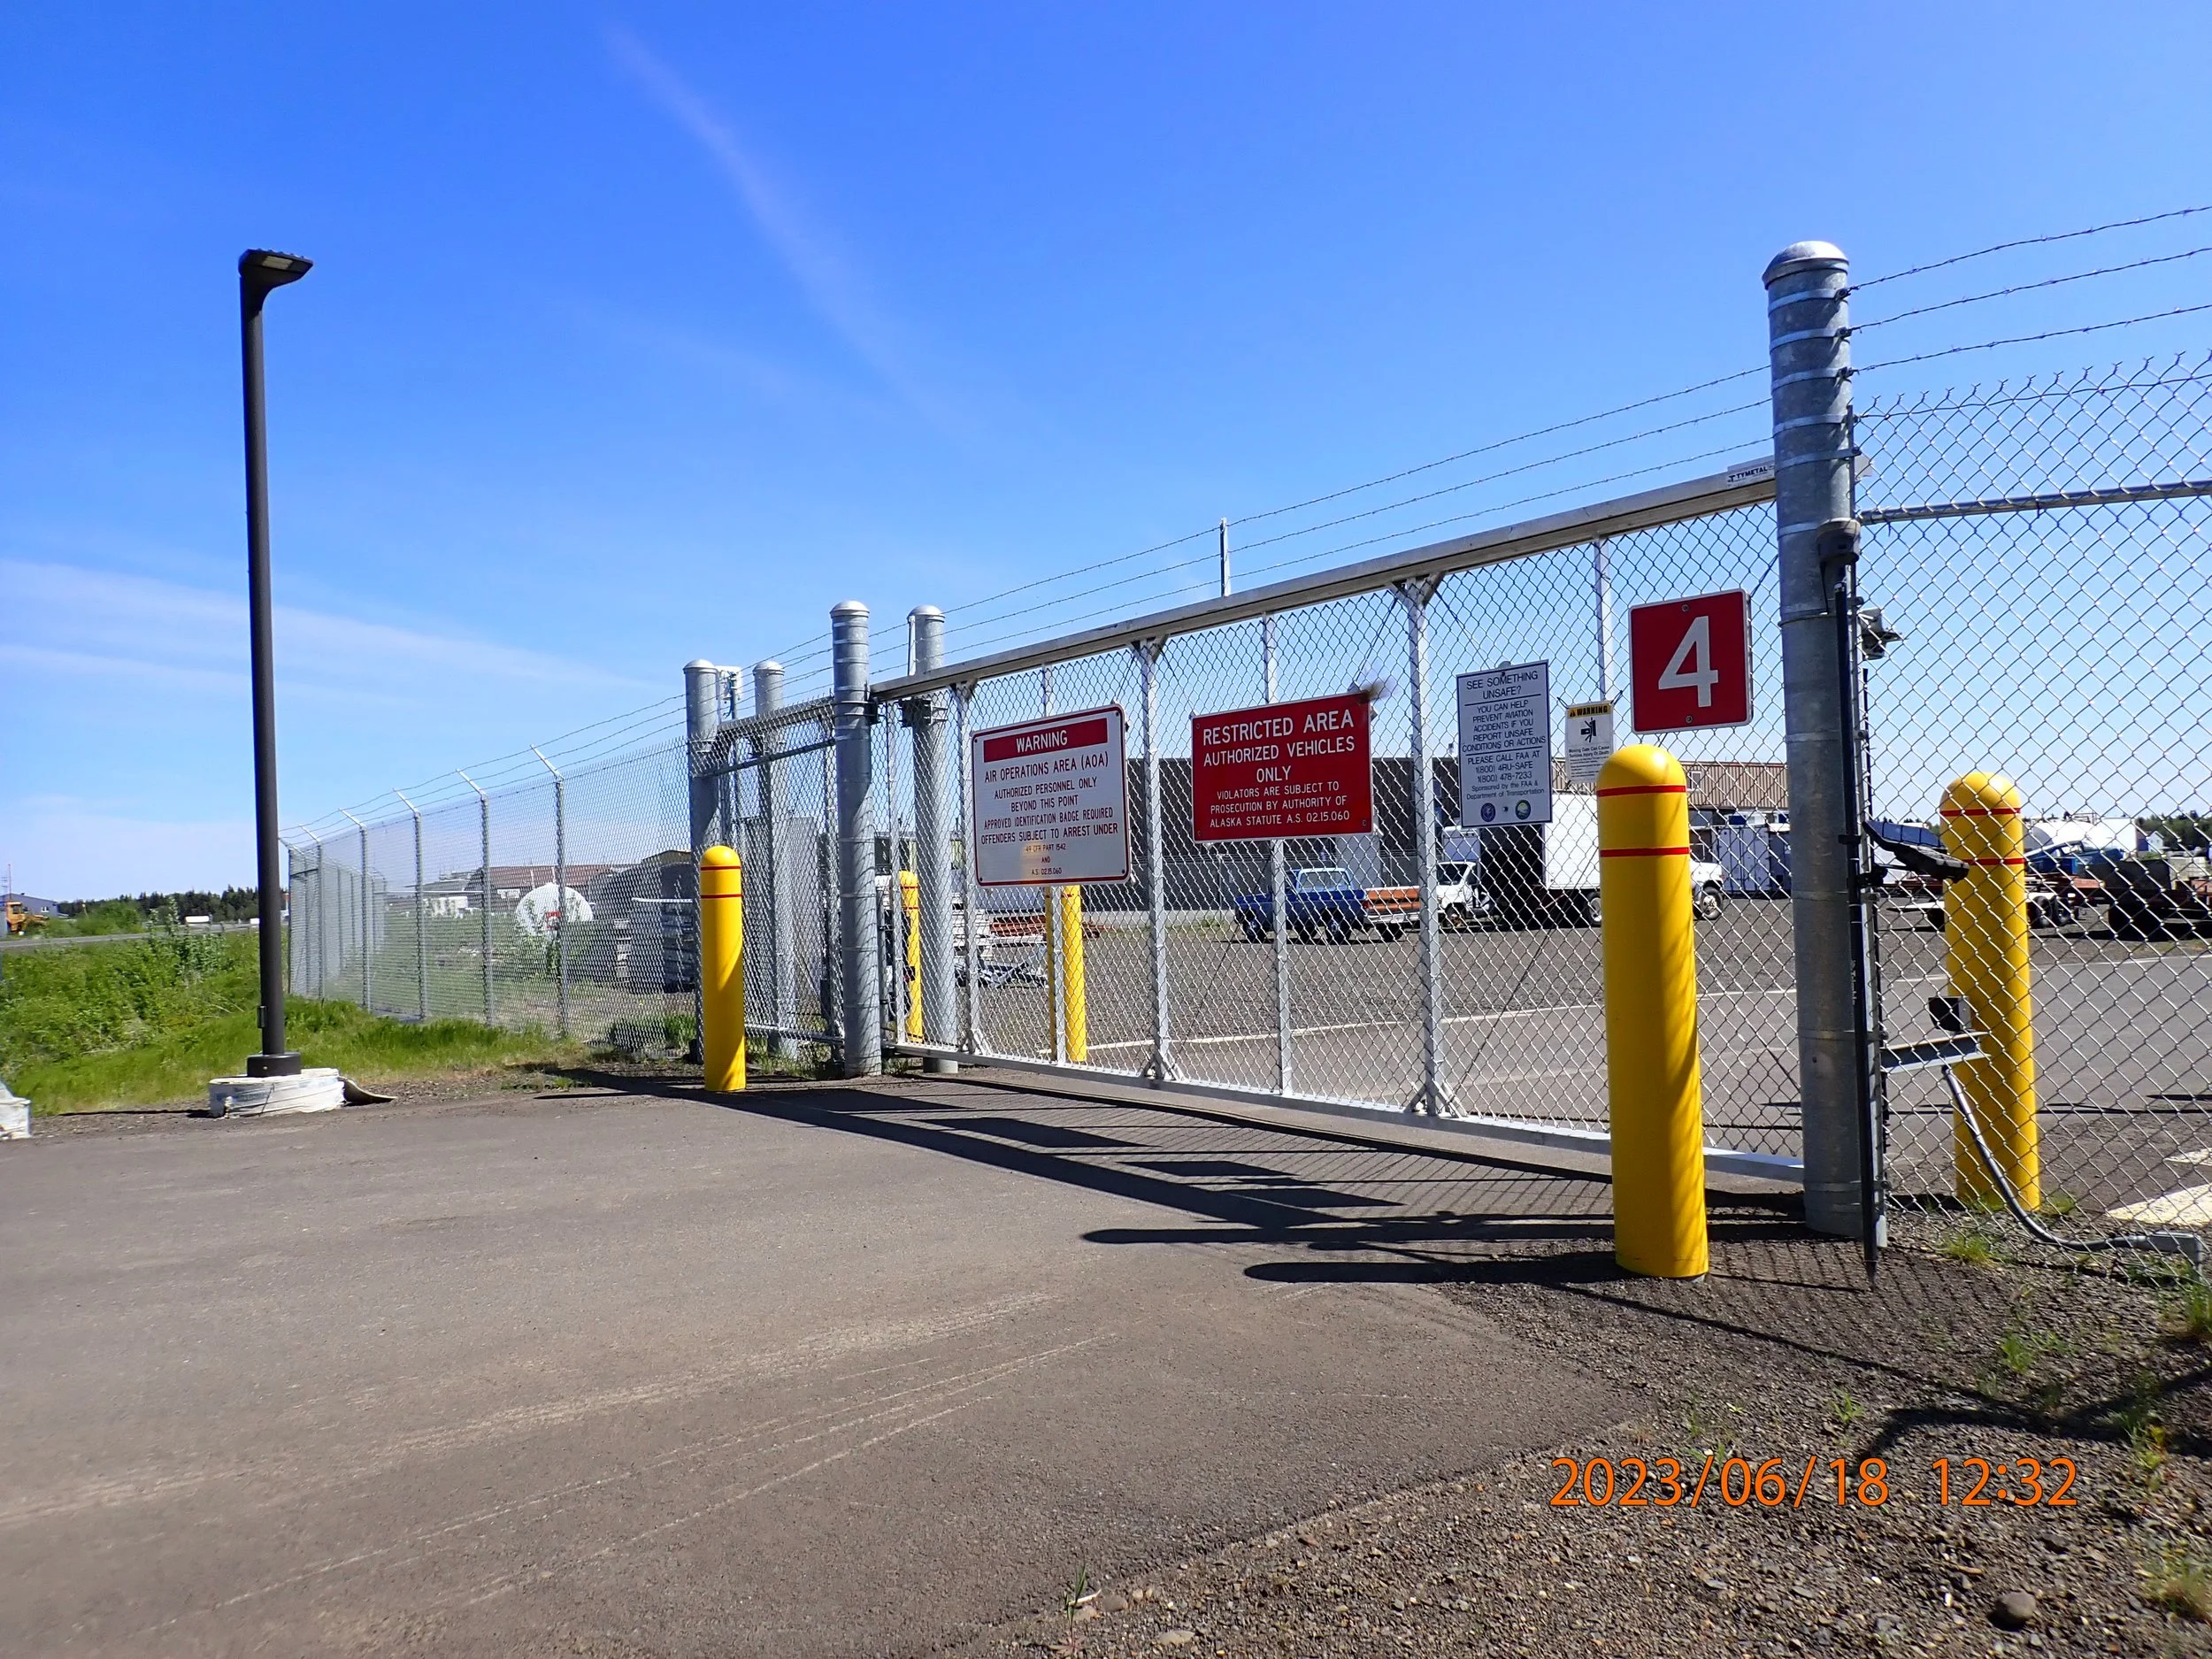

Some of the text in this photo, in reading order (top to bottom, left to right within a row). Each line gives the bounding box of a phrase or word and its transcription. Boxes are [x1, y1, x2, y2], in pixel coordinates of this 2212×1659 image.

[1736, 466, 1768, 479] TYMETAL
[1658, 616, 1718, 707] 4
[1466, 671, 1538, 690] SEE SOMETHING
[1483, 686, 1521, 700] UNSAFE?
[1494, 703, 1508, 711] CAN
[1510, 700, 1528, 709] HELP
[1577, 705, 1608, 716] WARNING
[1473, 709, 1533, 723] PREVENT AVIATION
[1203, 709, 1354, 746] RESTRICTED AREA
[1473, 722, 1509, 733] ACCIDENTS
[1520, 718, 1533, 727] YOU
[1017, 730, 1068, 753] WARNING
[1473, 728, 1533, 741] REPORT UNSAFE
[1203, 736, 1355, 766] AUTHORIZED VEHICLES
[1462, 741, 1502, 753] CONDITIONS
[1517, 736, 1547, 746] ACTIONS
[985, 751, 1109, 783] AIR OPERATIONS AREA (AOA)
[1468, 756, 1494, 764] PLEASE
[1256, 765, 1291, 782] ONLY
[1478, 771, 1532, 783] 1(800) 478-7233
[995, 777, 1097, 800] AUTHORIZED PERSONNEL ONLY
[1217, 781, 1339, 800] VIOLATORS ARE SUBJECT TO
[1011, 795, 1079, 812] BEYOND THIS POINT
[1210, 795, 1347, 814] PROSECUTION BY AUTHORITY OF
[984, 807, 1113, 830] APPROVED IDENTIFICATION BADGE REQUIRED
[1210, 810, 1349, 828] ALASKA STATUTE A.S. 02.15.060
[981, 823, 1118, 844] OFFENDERS SUBJECT TO ARREST UNDER
